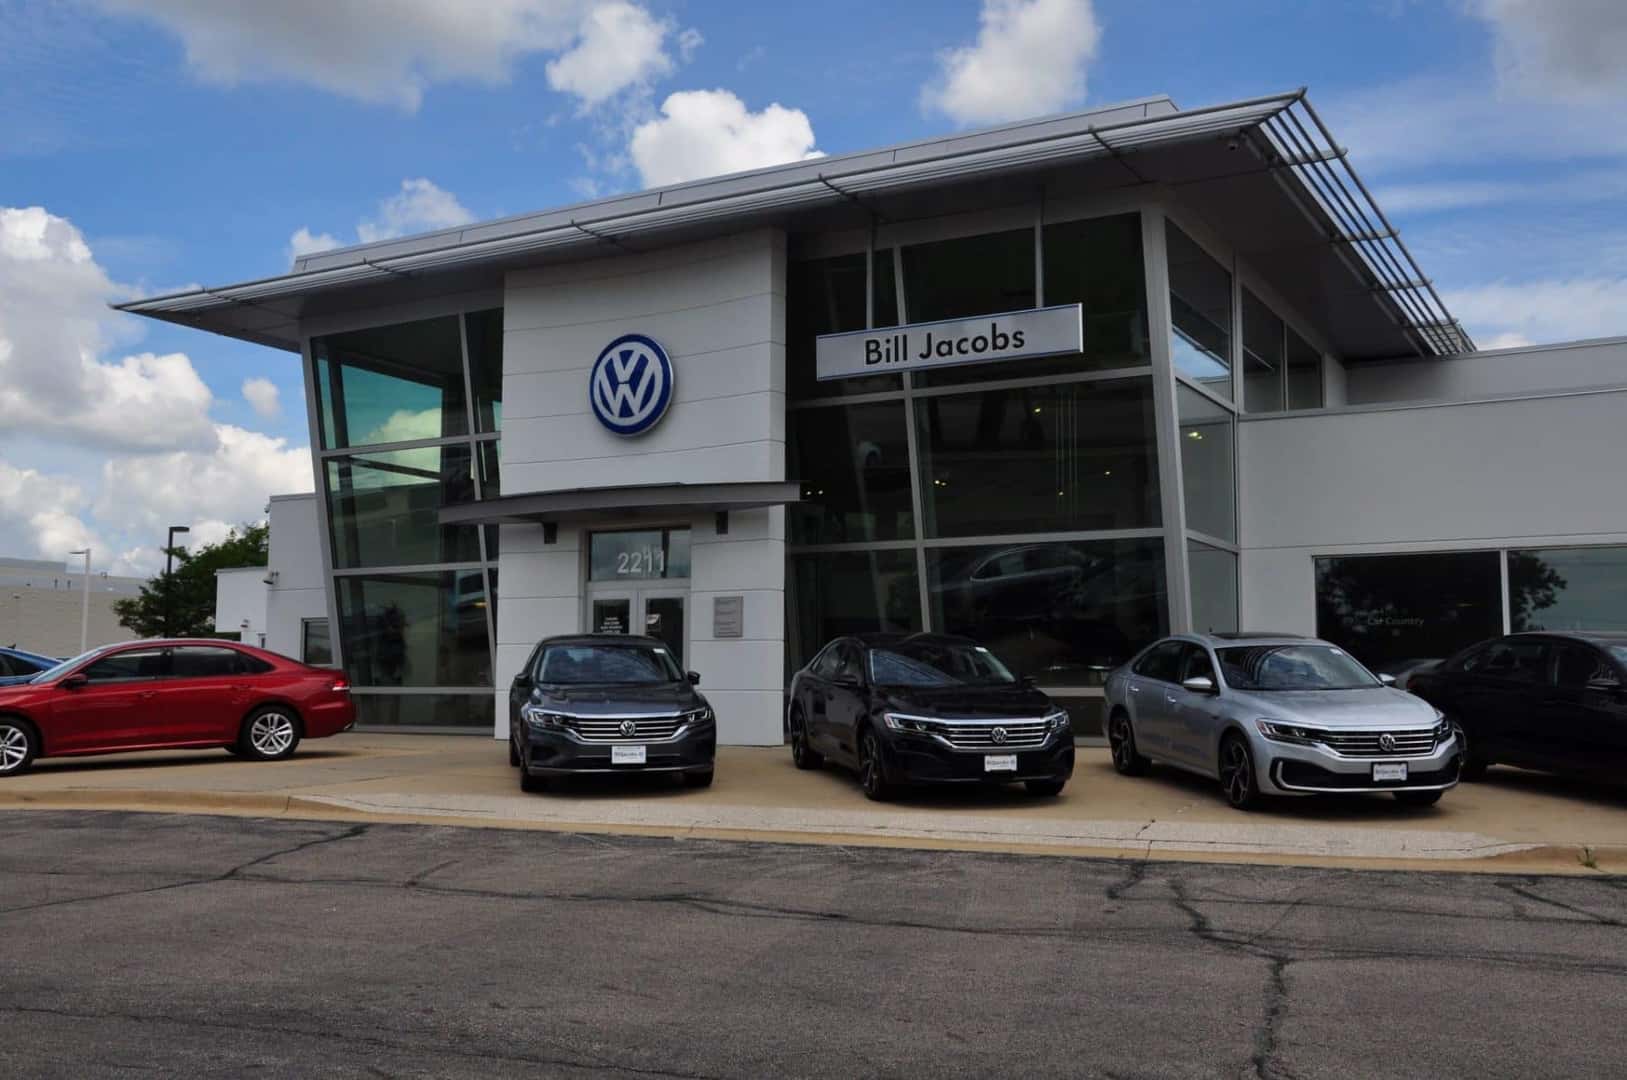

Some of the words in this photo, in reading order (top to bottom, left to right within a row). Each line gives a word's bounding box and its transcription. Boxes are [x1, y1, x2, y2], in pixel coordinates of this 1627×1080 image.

[865, 334, 908, 366] Bill
[919, 322, 1025, 360] Jacobs
[617, 550, 665, 574] 2211
